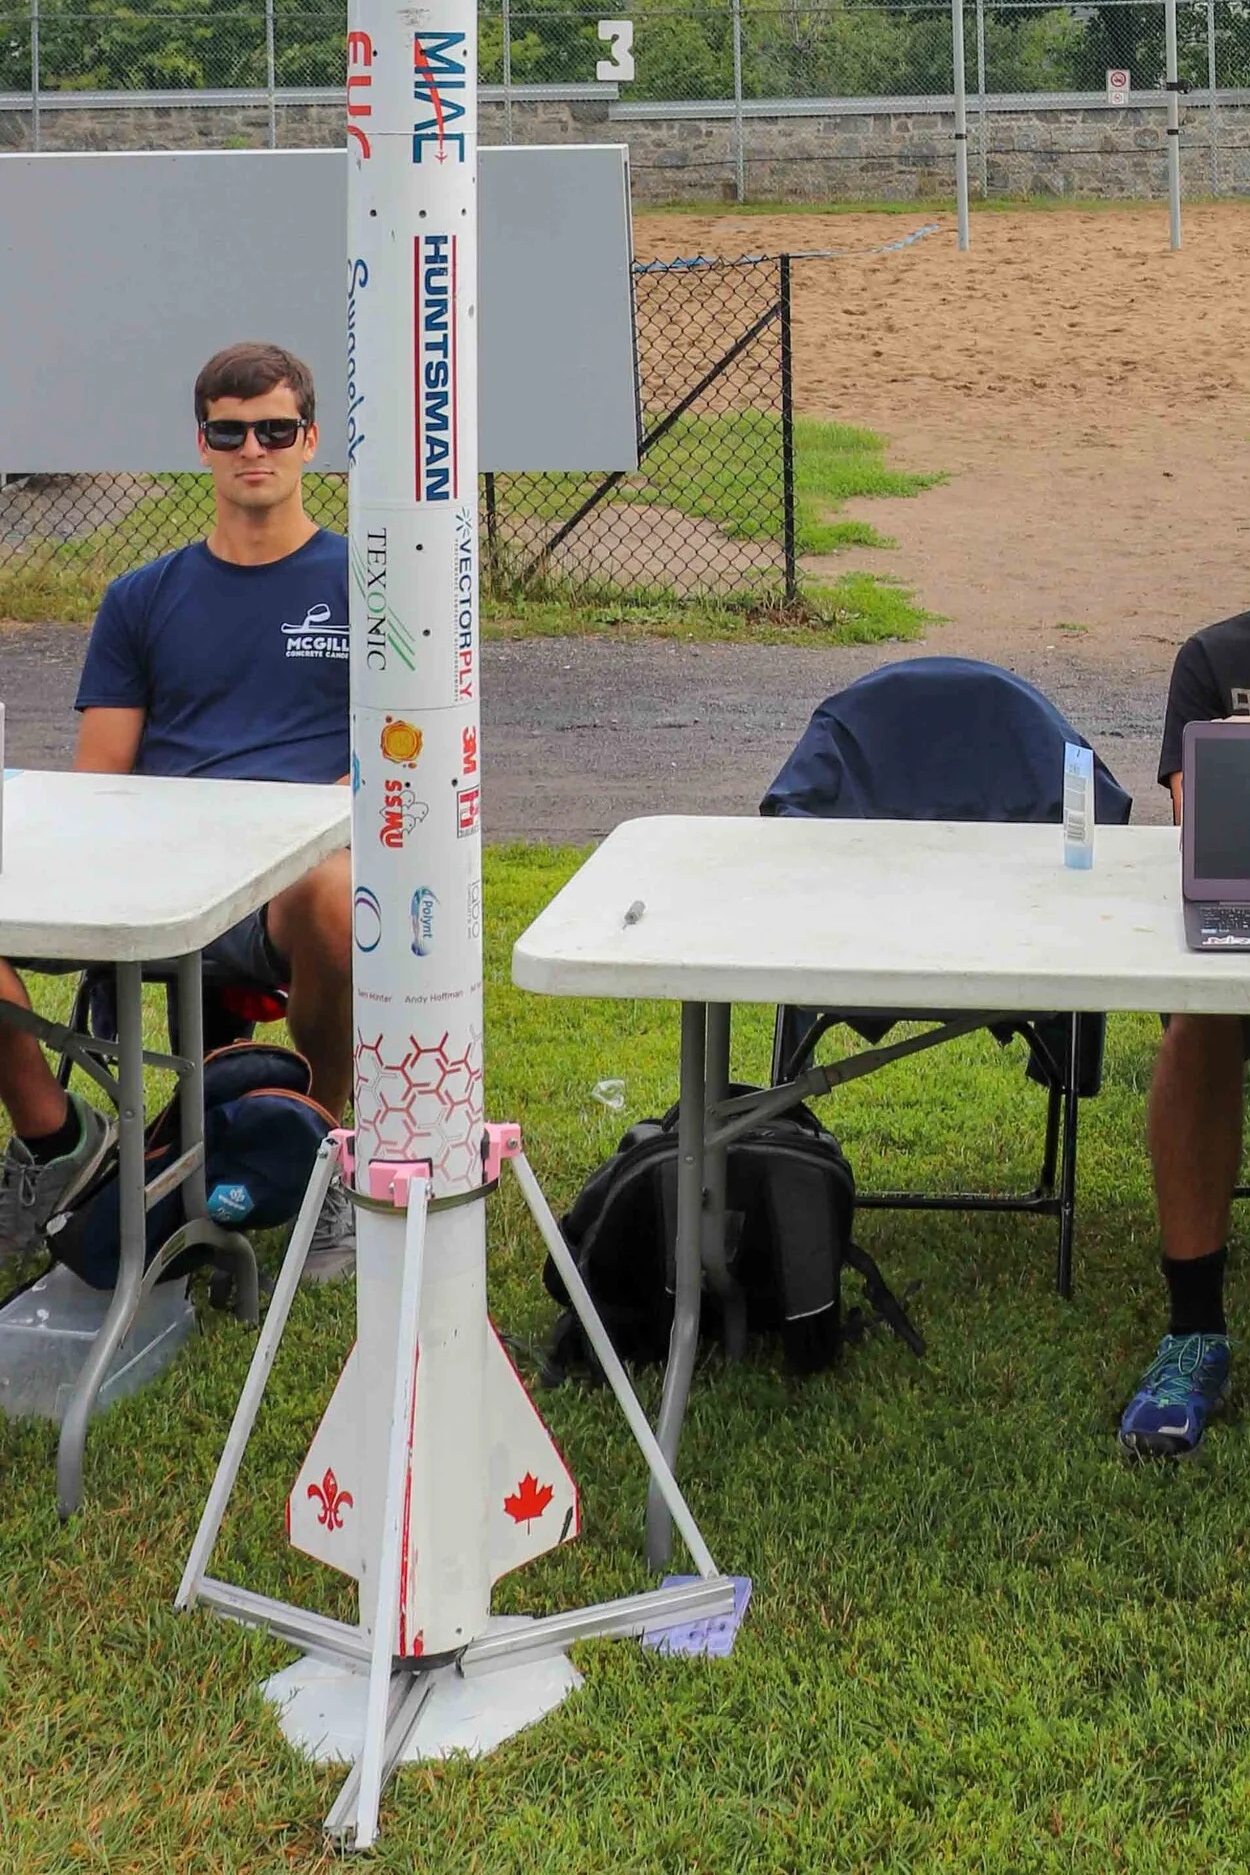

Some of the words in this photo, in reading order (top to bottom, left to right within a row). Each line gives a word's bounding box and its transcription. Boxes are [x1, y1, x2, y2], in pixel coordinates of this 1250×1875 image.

[423, 234, 451, 501] HUNTSMAN
[366, 528, 388, 672] TEXONIC
[458, 539, 473, 698] VECTORPLY
[285, 650, 324, 658] CONCRETE
[286, 636, 350, 652] MCGILL
[462, 725, 479, 776] 3M
[379, 779, 404, 849] SSMU
[419, 899, 434, 940] Polynt
